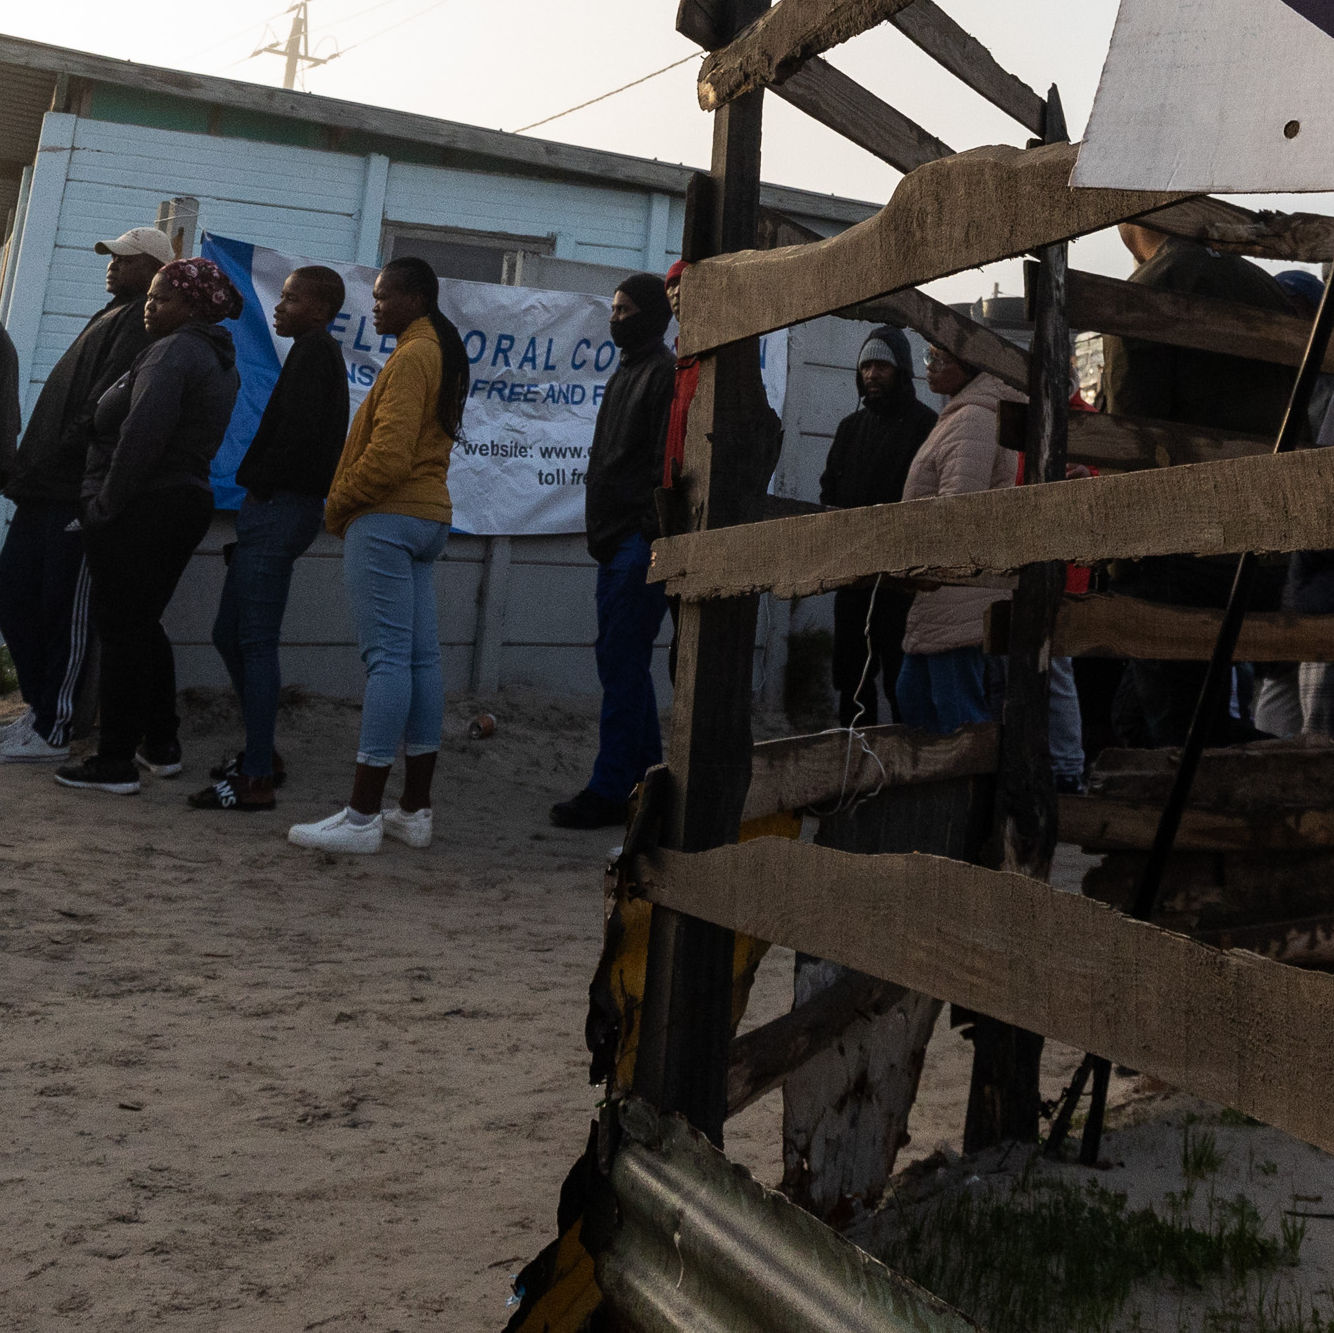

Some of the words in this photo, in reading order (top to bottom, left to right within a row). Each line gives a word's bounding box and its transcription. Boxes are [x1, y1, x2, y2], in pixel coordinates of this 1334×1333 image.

[469, 379, 538, 403] FREE
[542, 384, 586, 405] AND
[464, 440, 534, 459] website:
[538, 468, 565, 485] toll
